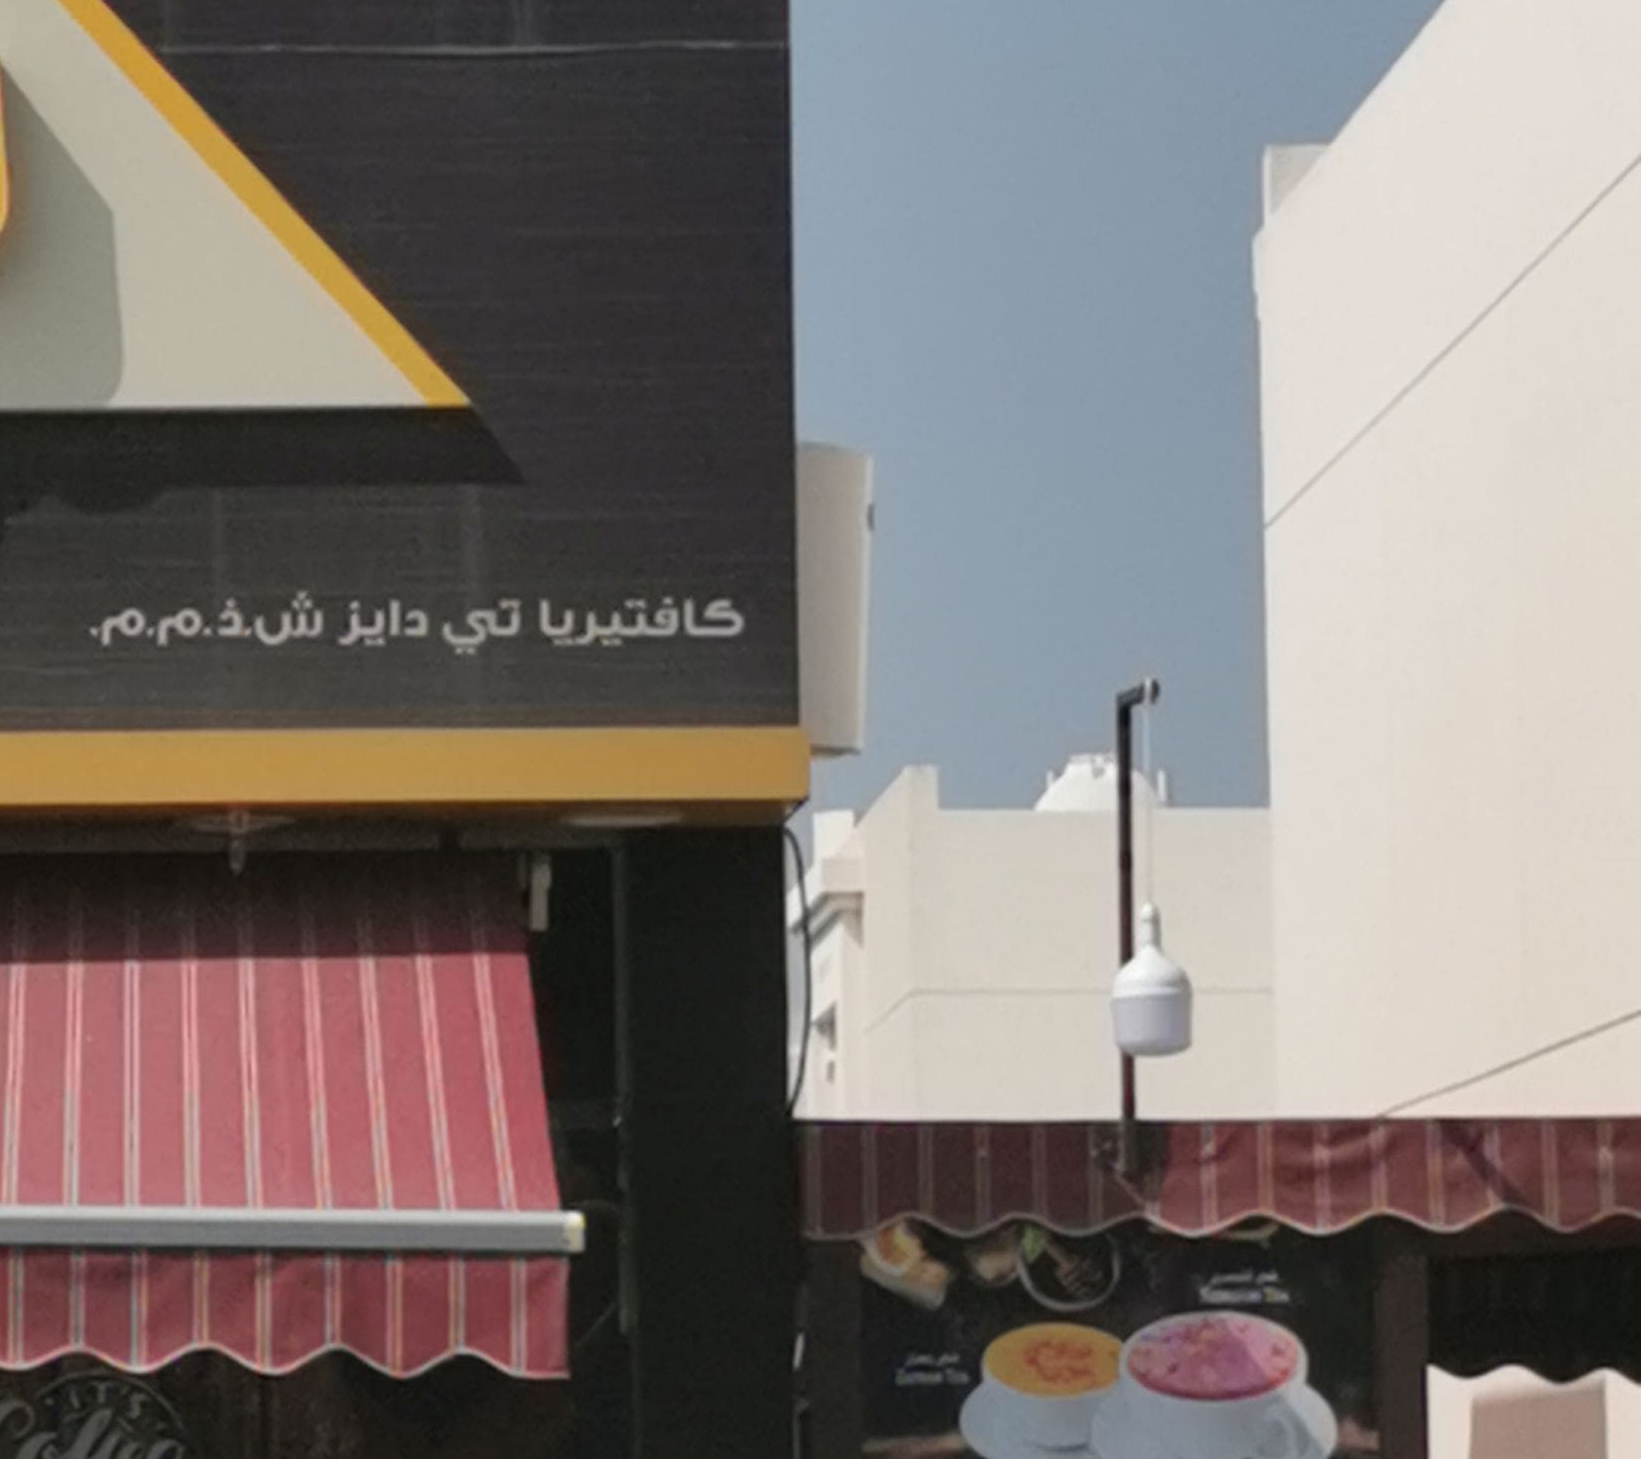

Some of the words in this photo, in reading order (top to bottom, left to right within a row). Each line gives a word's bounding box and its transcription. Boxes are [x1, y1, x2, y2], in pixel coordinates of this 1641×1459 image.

[337, 597, 429, 647] دايز
[441, 597, 521, 655] تي
[538, 596, 745, 647] كافتيريا
